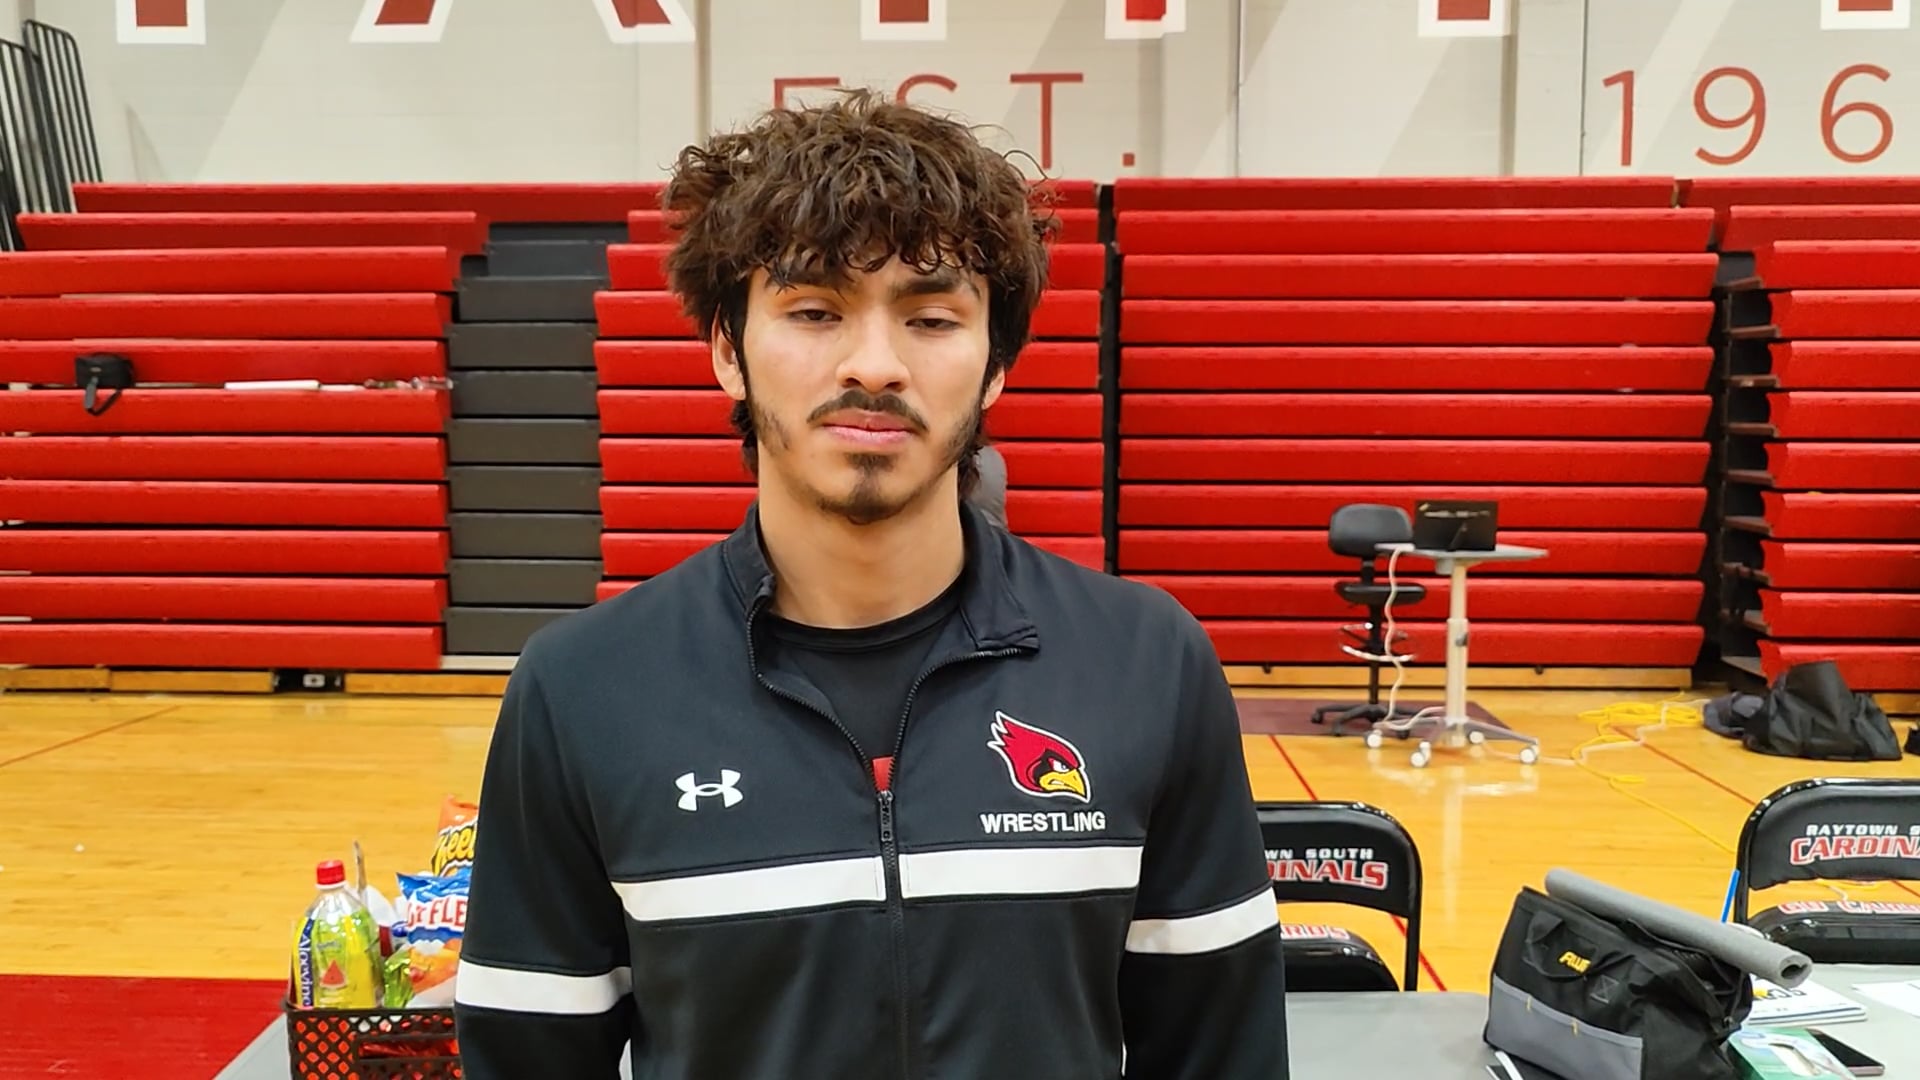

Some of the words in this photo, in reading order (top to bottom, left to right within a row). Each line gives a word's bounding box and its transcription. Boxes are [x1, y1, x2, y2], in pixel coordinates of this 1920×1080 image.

[1602, 63, 1894, 166] 196
[980, 811, 1106, 834] WRESTLING
[1806, 824, 1898, 836] RAYTOWN
[1305, 848, 1374, 860] SOUTH
[1790, 835, 1920, 865] CARDIN
